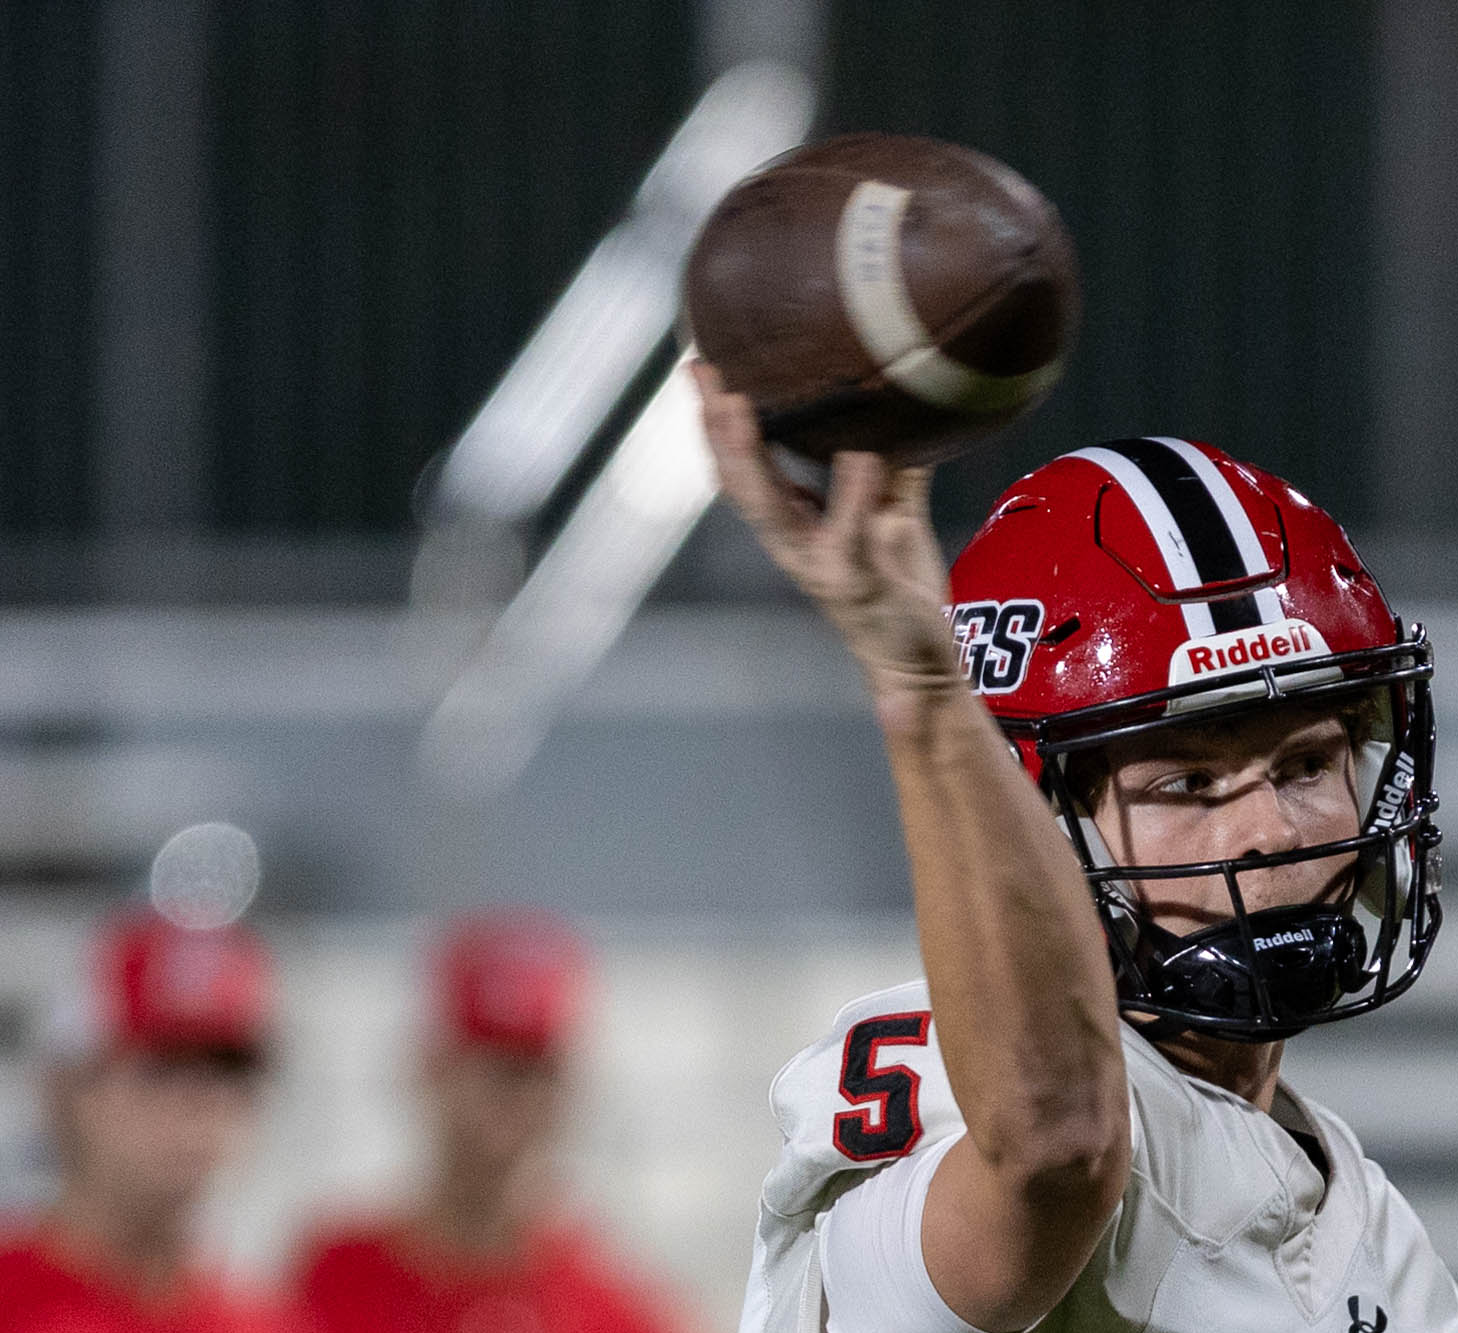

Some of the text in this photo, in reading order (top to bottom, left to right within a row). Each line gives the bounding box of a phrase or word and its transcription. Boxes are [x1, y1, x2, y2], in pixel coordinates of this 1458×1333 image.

[942, 599, 1045, 695] GS
[1187, 624, 1312, 674] Riddell
[1253, 928, 1315, 952] Riddell
[832, 1010, 930, 1163] 5
